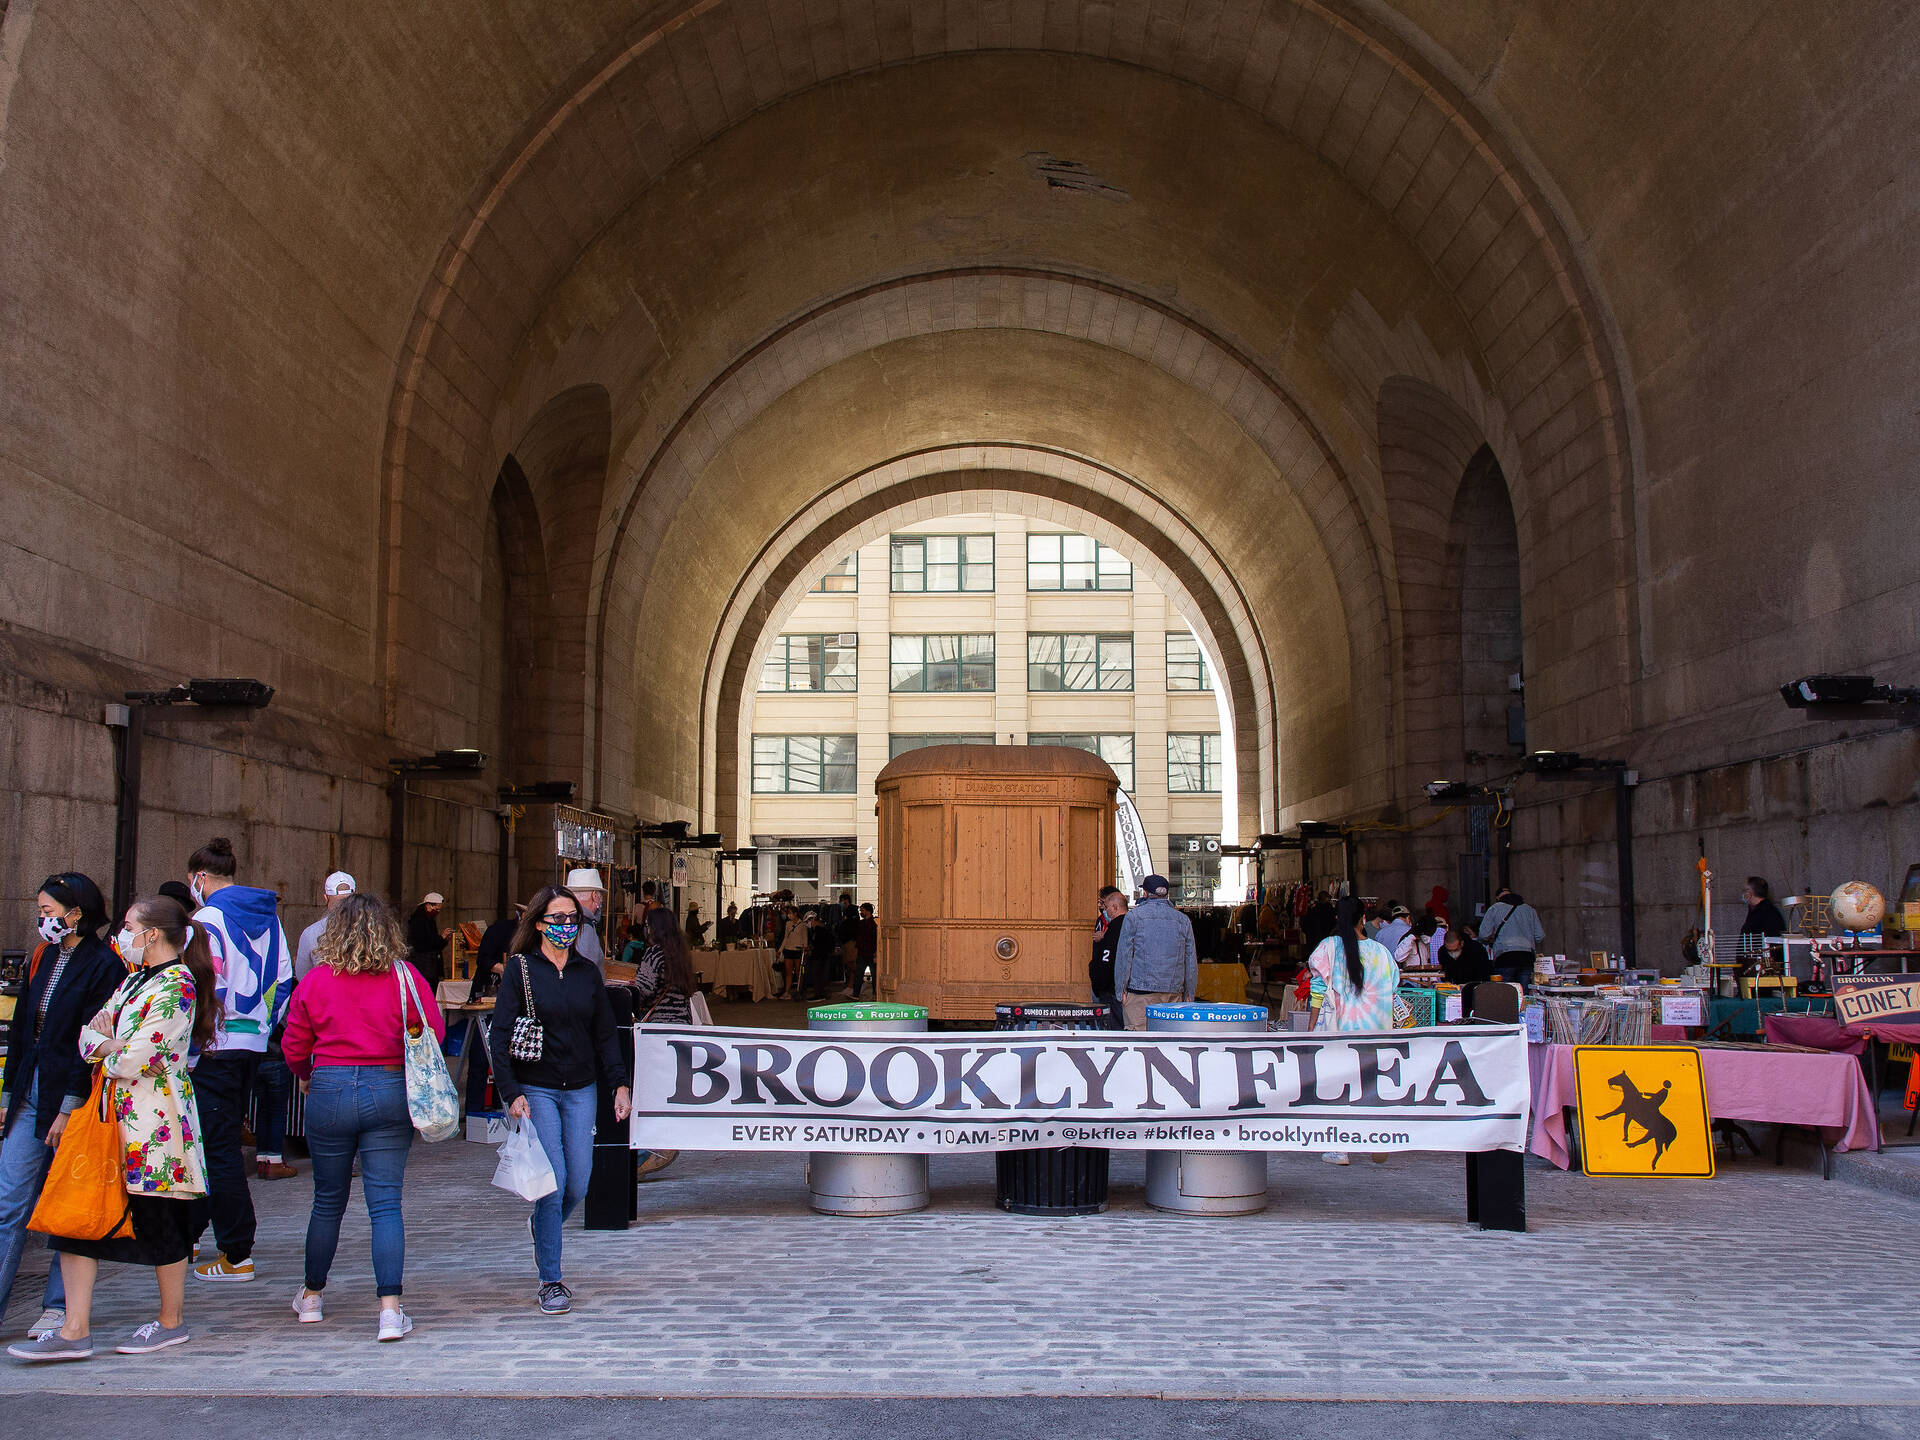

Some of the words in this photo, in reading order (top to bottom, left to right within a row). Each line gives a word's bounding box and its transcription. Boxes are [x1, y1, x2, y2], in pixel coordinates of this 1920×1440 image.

[965, 783, 1003, 792] DUMBO
[1004, 783, 1049, 793] STATION
[1102, 949, 1110, 962] 2
[1001, 966, 1012, 980] 3
[1837, 976, 1894, 984] BROOKLYN
[1842, 987, 1912, 1018] CONEY
[815, 1011, 847, 1020] Recycle
[870, 1011, 909, 1020] Recycle
[1024, 1008, 1042, 1016] DUMBO
[1153, 1010, 1185, 1020] Recycle
[1207, 1012, 1247, 1022] Recycle
[666, 1040, 1209, 1110] BROOKLYN
[1225, 1041, 1495, 1111] FLEA
[732, 1125, 797, 1142] EVERY
[804, 1126, 910, 1144] SATURDAY
[933, 1127, 1039, 1145] 10AM-5PM
[1062, 1125, 1137, 1142] @bkflea
[1144, 1124, 1215, 1141] #bkflea
[1238, 1124, 1409, 1146] brooklynflea.com
